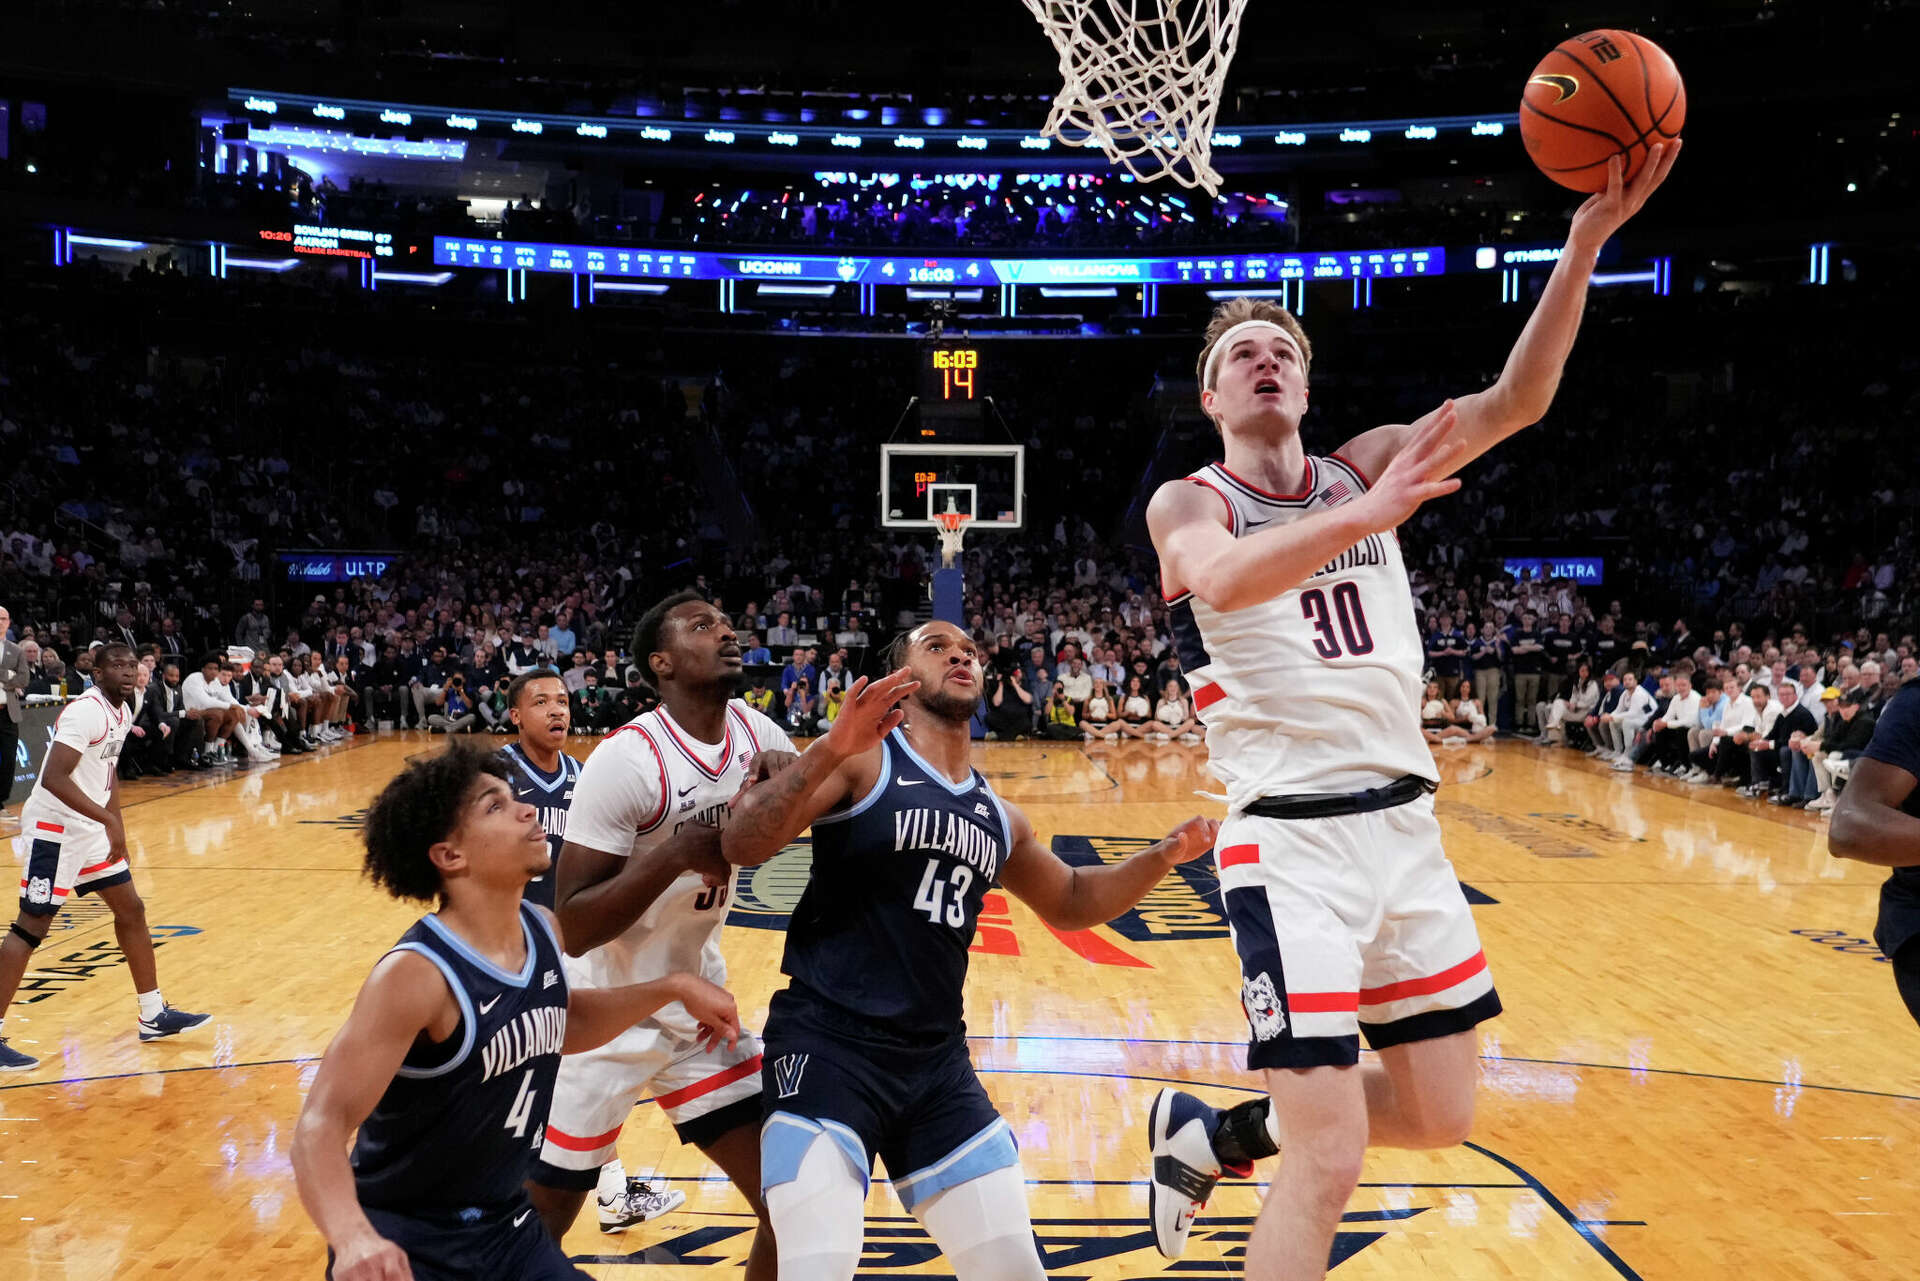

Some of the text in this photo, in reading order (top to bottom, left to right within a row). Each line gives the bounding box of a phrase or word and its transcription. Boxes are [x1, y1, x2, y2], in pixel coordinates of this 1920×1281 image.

[245, 96, 277, 113] Jeep
[313, 103, 344, 120] Jeep
[380, 109, 411, 125] Jeep
[447, 114, 477, 130] Jeep
[512, 119, 542, 134] Jeep
[577, 123, 607, 138] Jeep
[641, 126, 671, 141] Jeep
[1405, 125, 1436, 139] Jeep
[1472, 122, 1503, 136] Jeep
[705, 129, 735, 144] Jeep
[768, 132, 798, 146] Jeep
[831, 133, 861, 148] Jeep
[894, 135, 924, 149] Jeep
[957, 135, 987, 150] Jeep
[1020, 135, 1050, 150] Jeep
[1211, 133, 1241, 147] Jeep
[1275, 131, 1305, 145] Jeep
[1340, 128, 1371, 142] Jeep
[294, 225, 339, 238] BOWLING
[339, 229, 373, 241] GREEN
[294, 236, 338, 249] AKRON
[327, 248, 371, 258] BASKETBALL
[739, 261, 801, 275] UCONN
[881, 262, 895, 276] 4
[909, 268, 955, 281] 16:03
[966, 262, 980, 277] 4
[1049, 264, 1139, 276] VILLANOVA
[933, 351, 978, 369] 16:03
[944, 369, 974, 399] 14
[1300, 581, 1375, 660] 30
[894, 808, 998, 884] VILLANOVA
[912, 858, 974, 929] 43
[503, 1068, 537, 1139] 4
